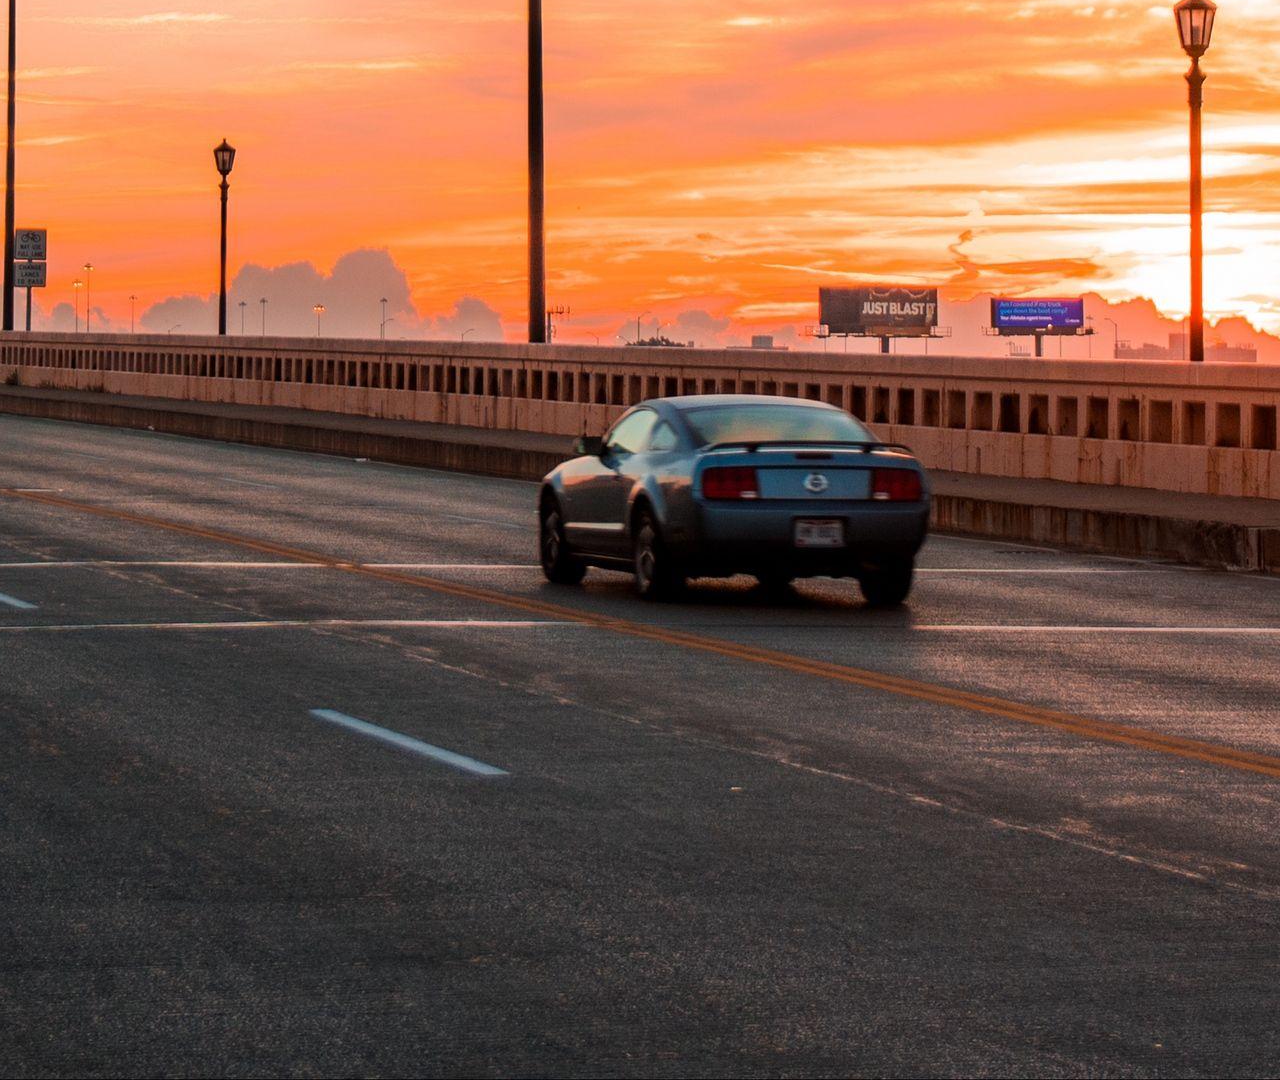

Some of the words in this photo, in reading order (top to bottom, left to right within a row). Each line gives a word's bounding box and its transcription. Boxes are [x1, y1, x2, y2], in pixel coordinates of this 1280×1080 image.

[862, 301, 888, 315] JUST
[889, 302, 925, 315] BLAST
[926, 302, 936, 315] IT
